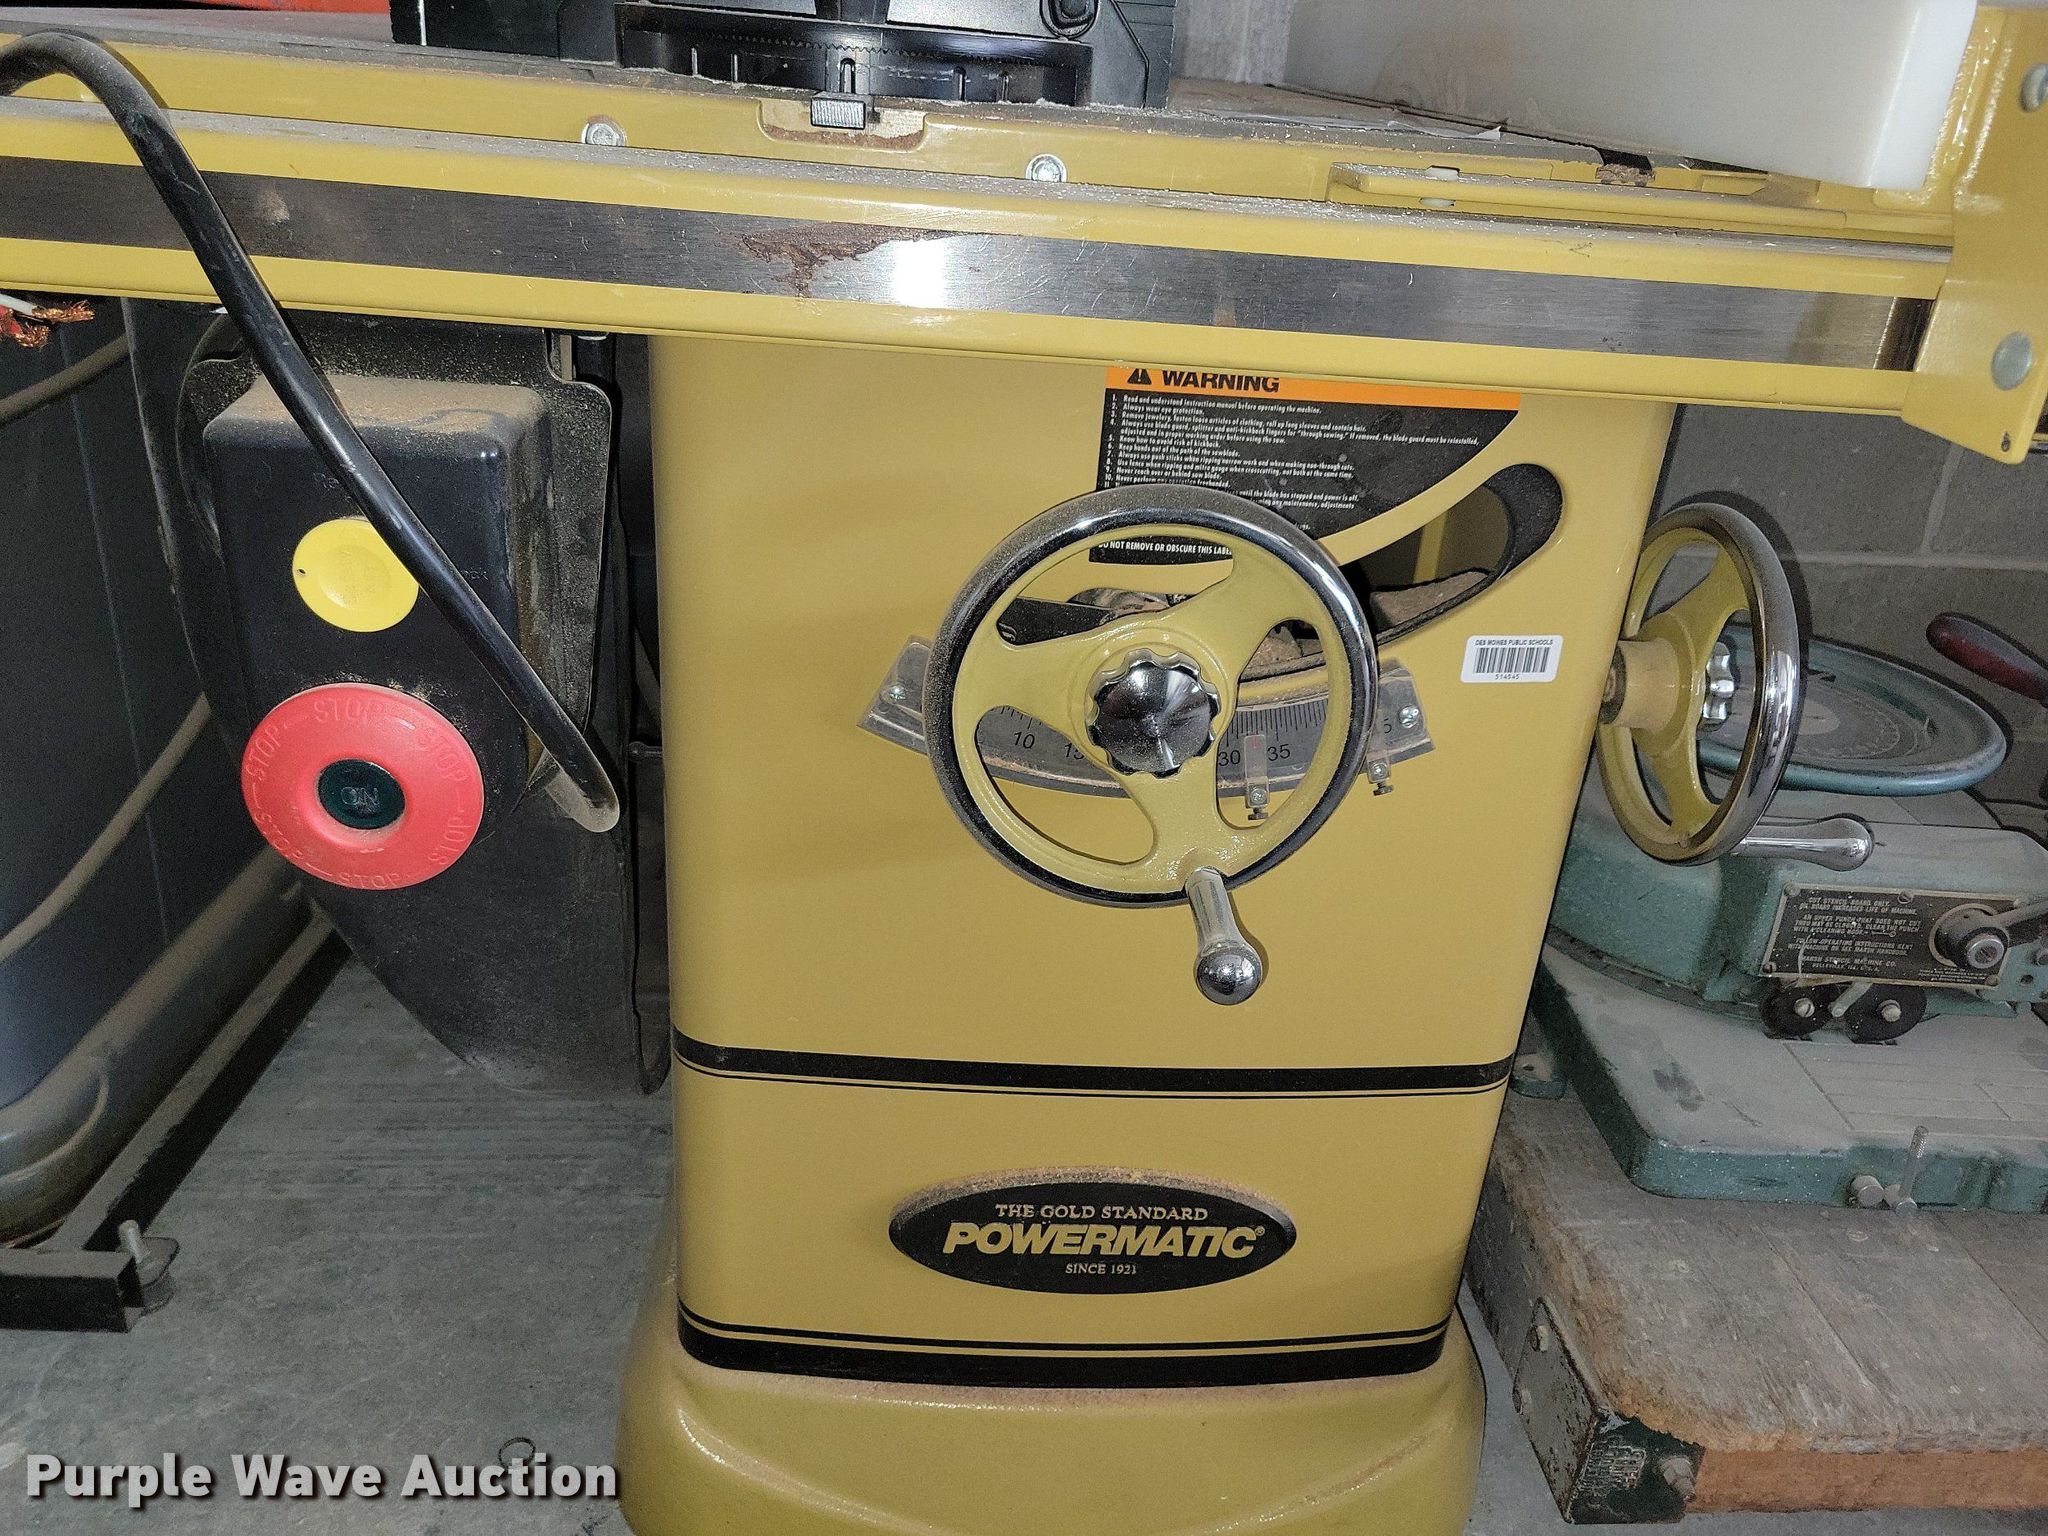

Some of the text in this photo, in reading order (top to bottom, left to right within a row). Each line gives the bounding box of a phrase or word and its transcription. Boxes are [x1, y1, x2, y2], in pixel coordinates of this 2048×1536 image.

[1161, 370, 1280, 393] WARNING
[1122, 403, 1144, 413] Always
[1172, 407, 1204, 417] protection.
[1151, 397, 1183, 405] understand
[1216, 401, 1237, 409] manual
[1238, 402, 1256, 410] before
[1258, 404, 1285, 413] operating
[1297, 406, 1321, 414] machine.
[1122, 412, 1144, 420] Remove
[1173, 414, 1191, 423] fasten
[1209, 417, 1231, 425] articles
[1240, 419, 1265, 428] clothing,
[1120, 428, 1146, 437] adjusted
[1165, 431, 1184, 440] proper
[1185, 431, 1209, 441] working
[1227, 433, 1245, 441] before
[1122, 419, 1143, 429] Always
[1266, 427, 1286, 437] fingers
[1134, 444, 1150, 452] hands
[1194, 440, 1220, 448] kickback.
[1118, 451, 1140, 461] Always
[1200, 456, 1220, 465] ripping
[1285, 460, 1306, 469] making
[1117, 467, 1133, 475] Never
[1172, 470, 1190, 479] behind
[1205, 472, 1222, 480] blade.
[1162, 462, 1182, 471] ripping
[1211, 465, 1228, 473] gauge
[1291, 491, 1312, 501] stopped
[1324, 494, 1341, 502] power
[1110, 541, 1125, 549] NOT
[1126, 541, 1154, 551] REMOVE
[1155, 543, 1165, 551] OR
[1166, 544, 1196, 553] OBSCURE
[1198, 546, 1213, 554] THIS
[1014, 731, 1035, 749] 10
[1218, 744, 1291, 766] 30 35
[996, 1204, 1208, 1221] THE GOLD STANDARD
[1066, 1263, 1137, 1275] SINCE 1921
